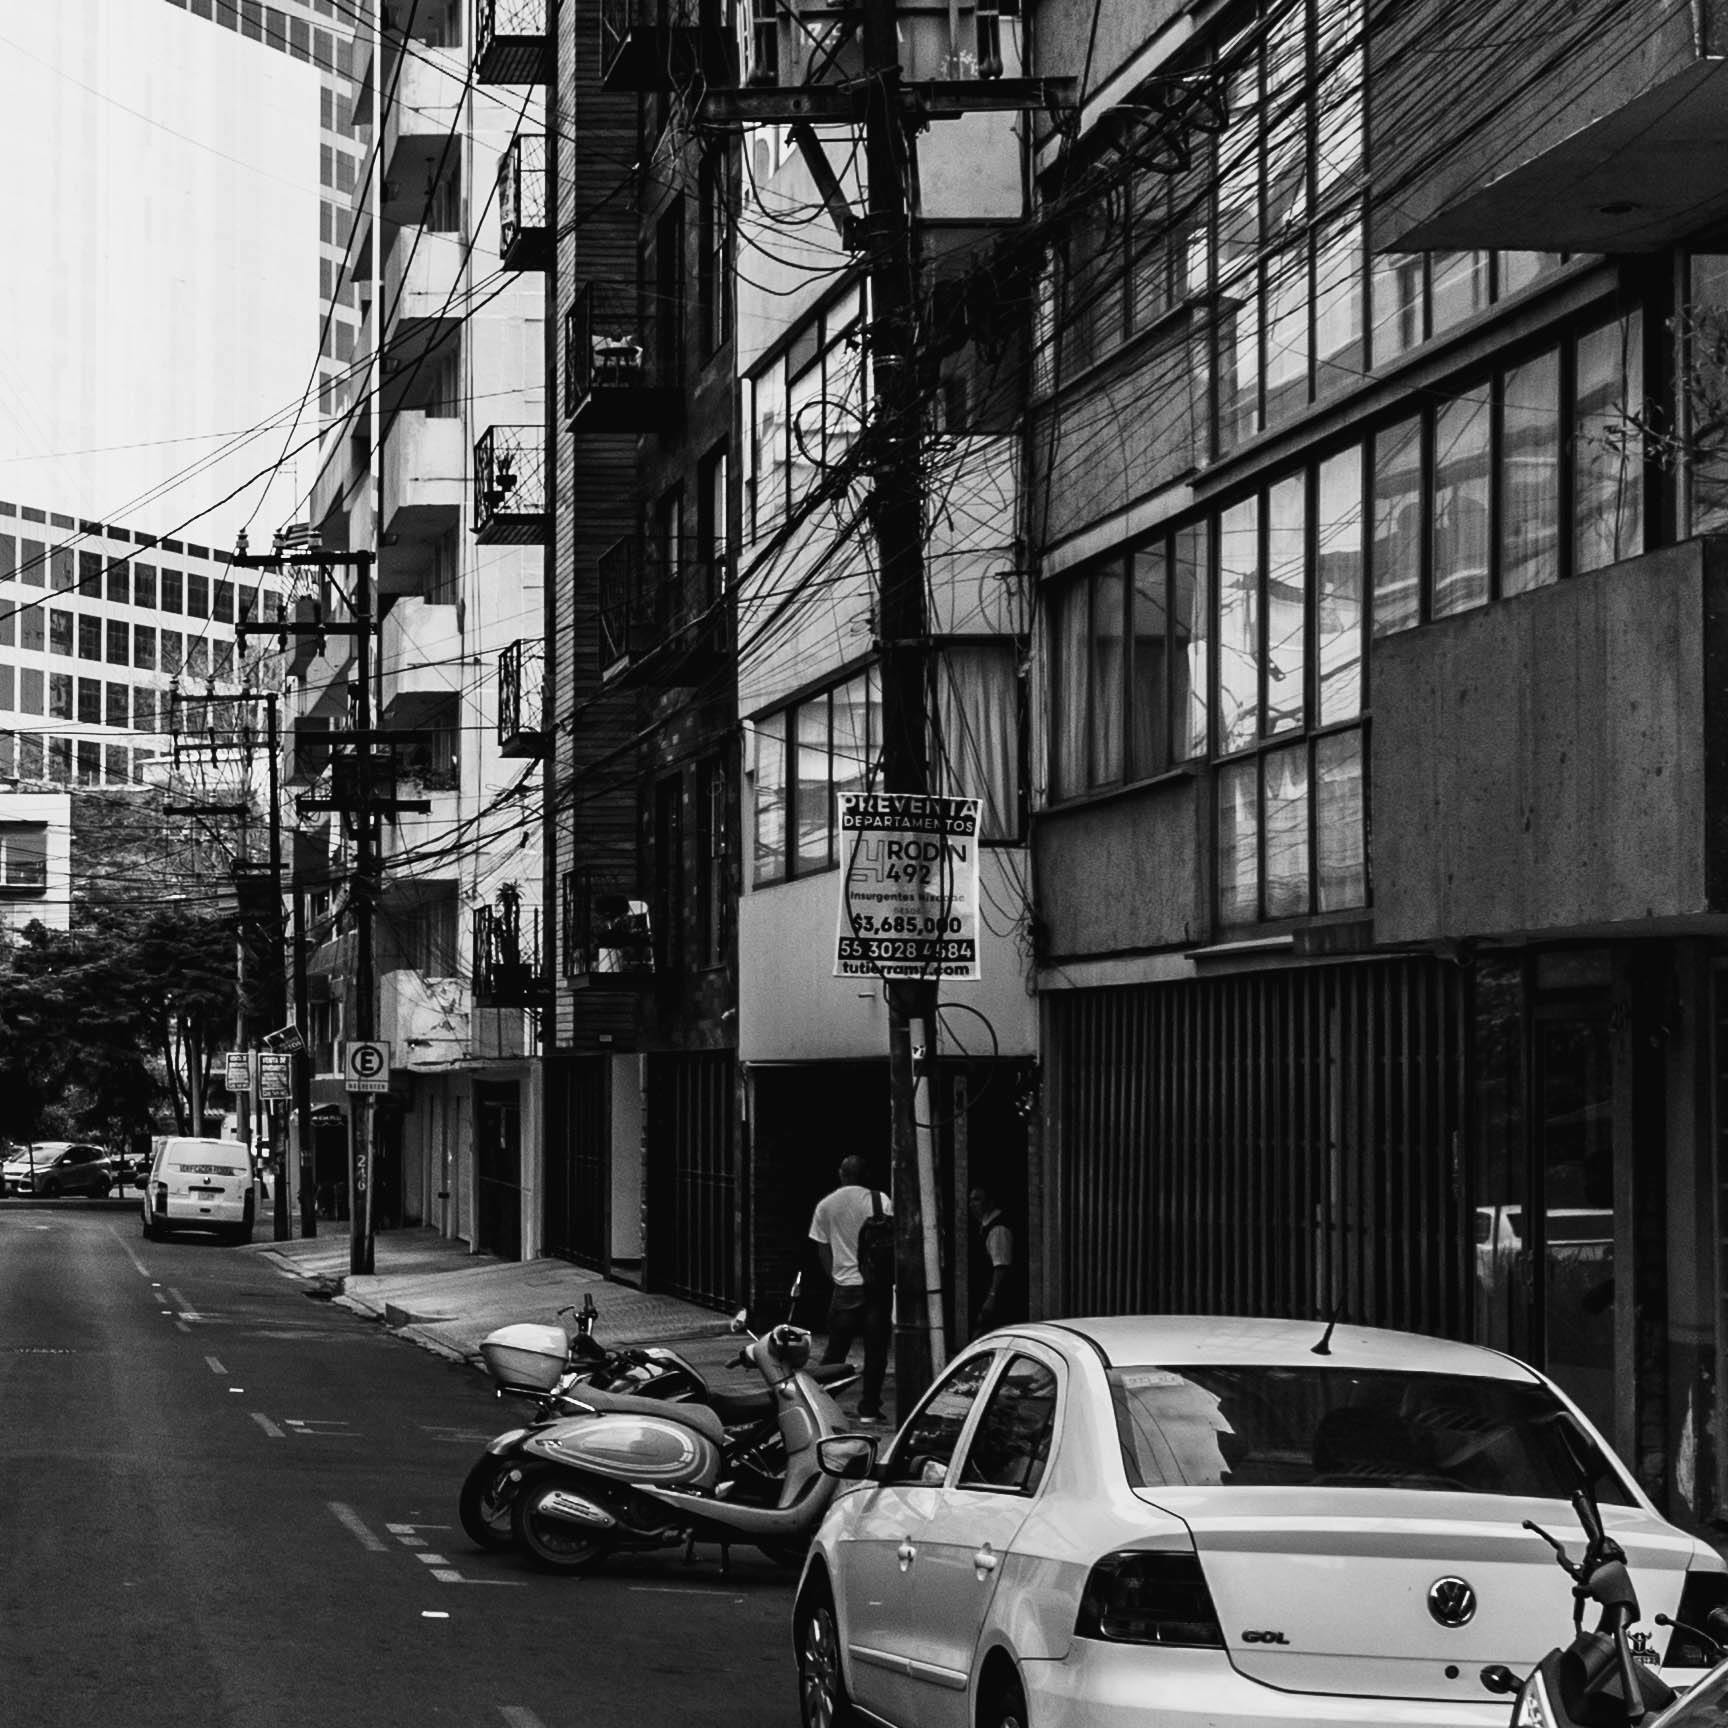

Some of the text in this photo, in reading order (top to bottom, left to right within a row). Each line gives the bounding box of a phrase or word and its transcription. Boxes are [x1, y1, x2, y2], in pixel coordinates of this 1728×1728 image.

[843, 796, 978, 819] PREVENTA
[843, 815, 974, 833] DEPARTAMENTOS
[887, 840, 967, 863] RODIN
[886, 863, 931, 885] 492
[850, 890, 914, 903] Insurgentes
[853, 913, 962, 935] $3,685,000
[841, 940, 863, 956] 55
[868, 941, 917, 958] 3028
[1241, 1630, 1290, 1645] GOL
